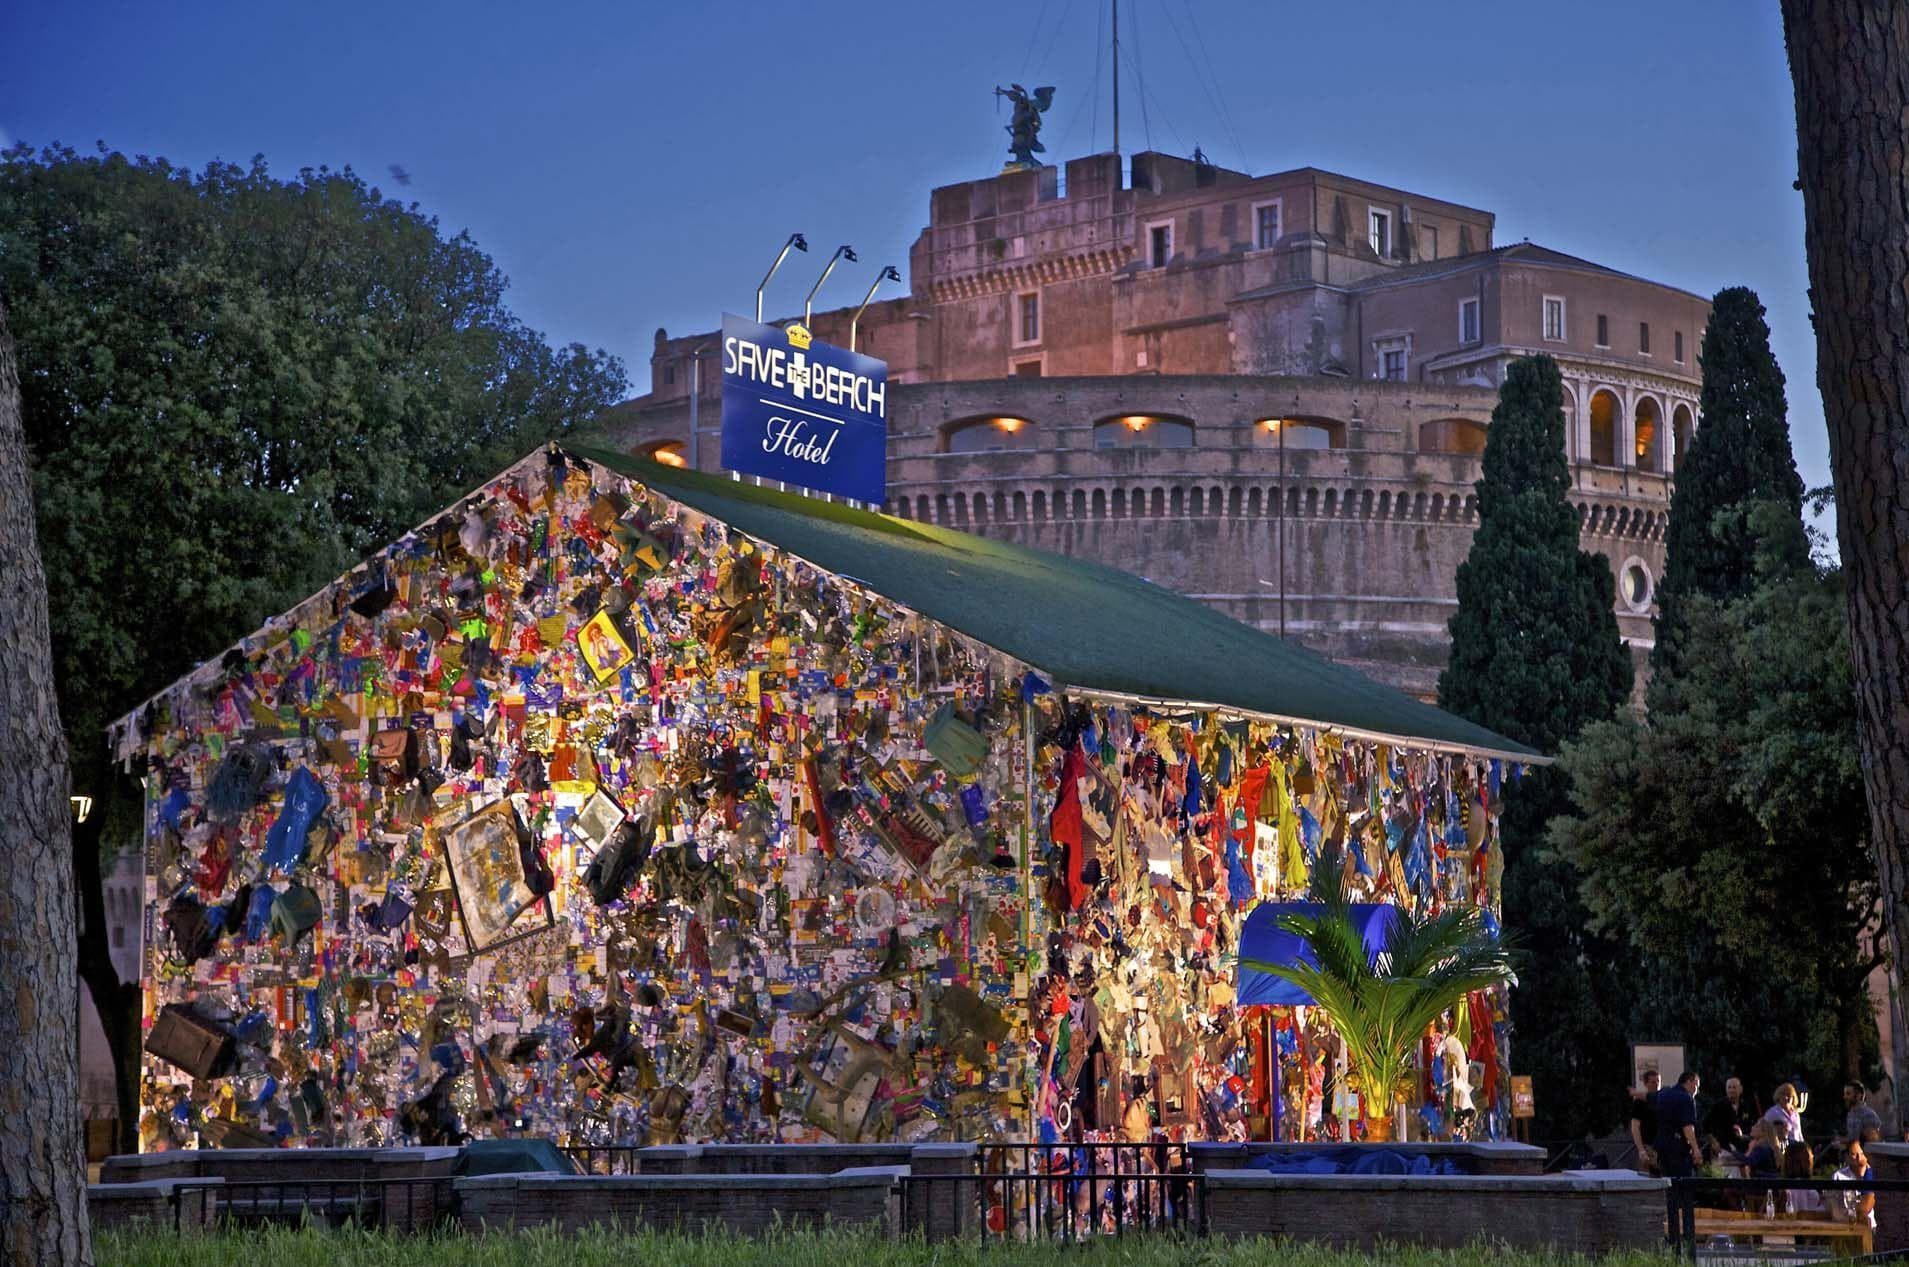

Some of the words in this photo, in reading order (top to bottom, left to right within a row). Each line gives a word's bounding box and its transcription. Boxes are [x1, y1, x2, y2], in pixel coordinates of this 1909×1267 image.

[725, 337, 785, 388] SAVE
[790, 366, 808, 384] THE
[812, 362, 885, 418] BEACH
[762, 416, 840, 465] Hotel
